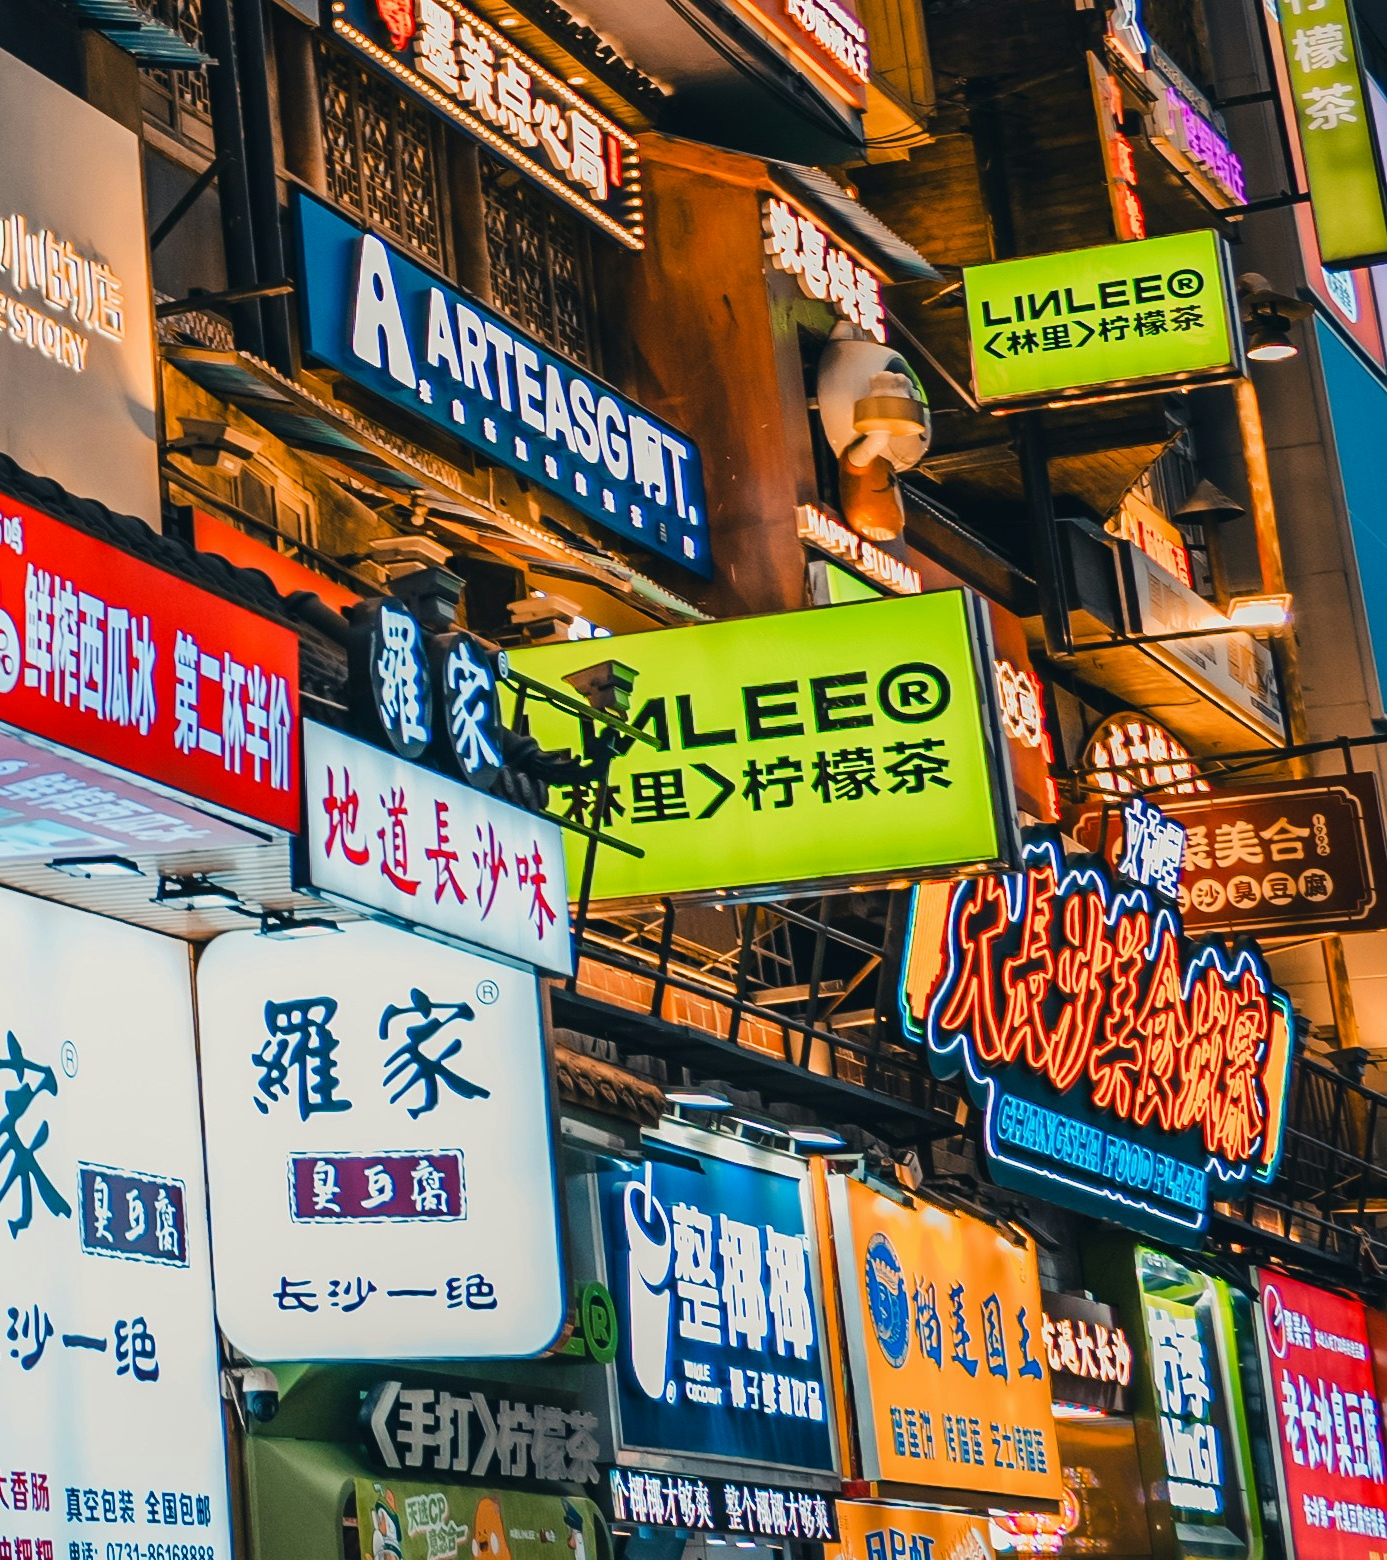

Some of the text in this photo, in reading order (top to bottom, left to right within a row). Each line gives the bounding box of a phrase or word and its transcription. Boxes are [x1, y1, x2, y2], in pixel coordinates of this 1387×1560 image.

[24, 563, 292, 791] 鲜榨西瓜冰 第二杯半价
[321, 765, 558, 942] 地道長沙味
[254, 987, 491, 1119] 羅家
[999, 1094, 1100, 1168] CHANGSHA
[1103, 1134, 1154, 1192] FOOD
[272, 1276, 498, 1313] 长沙一绝
[65, 1489, 213, 1528] 真空包装 全国包邮
